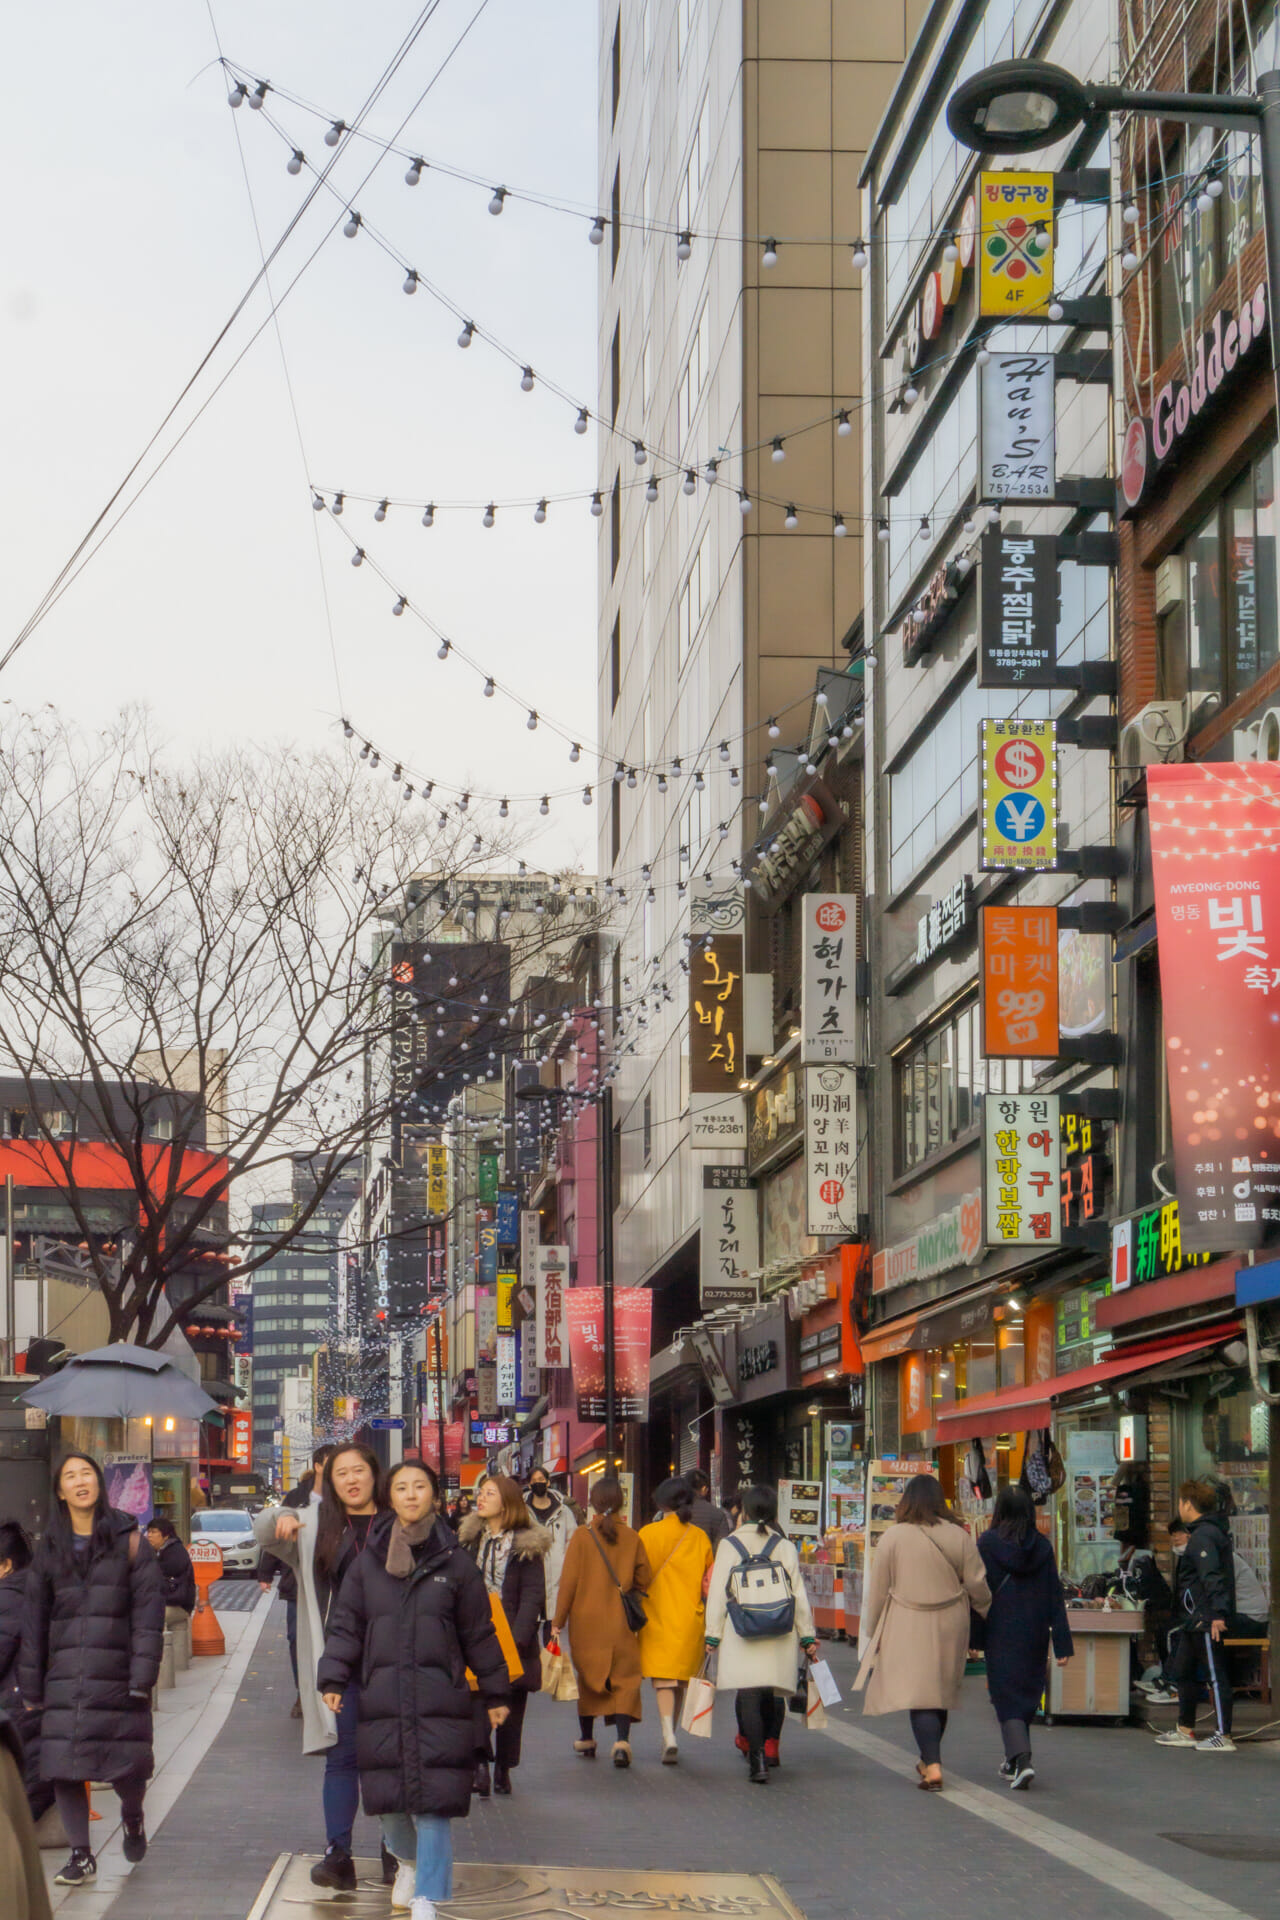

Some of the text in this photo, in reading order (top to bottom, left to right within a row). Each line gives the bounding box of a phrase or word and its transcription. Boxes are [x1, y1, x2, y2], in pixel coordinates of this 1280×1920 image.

[985, 184, 1049, 203] 킹당구장
[1005, 289, 1025, 302] 4F
[1153, 282, 1266, 460] Goddess
[991, 463, 1049, 480] BAR
[988, 483, 1049, 495] 757-2534
[1001, 538, 1036, 646] 봉추찜닭
[1012, 669, 1025, 681] 2F
[994, 724, 1045, 736] 로얄환전
[1170, 880, 1261, 894] MYEONG-DONG
[989, 916, 1051, 946] 롯데
[1171, 894, 1269, 961] 명동 빛
[989, 954, 1052, 984] 마켓
[813, 936, 847, 1035] 현가츠
[695, 951, 740, 1073] 왕비집
[997, 988, 1046, 1021] 999
[811, 1094, 851, 1113] 明洞
[694, 1124, 744, 1134] 776-2361
[813, 1118, 830, 1177] 양꼬치
[834, 1118, 850, 1178] 羊肉串
[996, 1130, 1021, 1240] 한방보쌈
[1028, 1130, 1054, 1239] 아구찜
[888, 1215, 959, 1280] LOTTE Market
[485, 1427, 509, 1441] 명동
[190, 1547, 217, 1557] 주차금지
